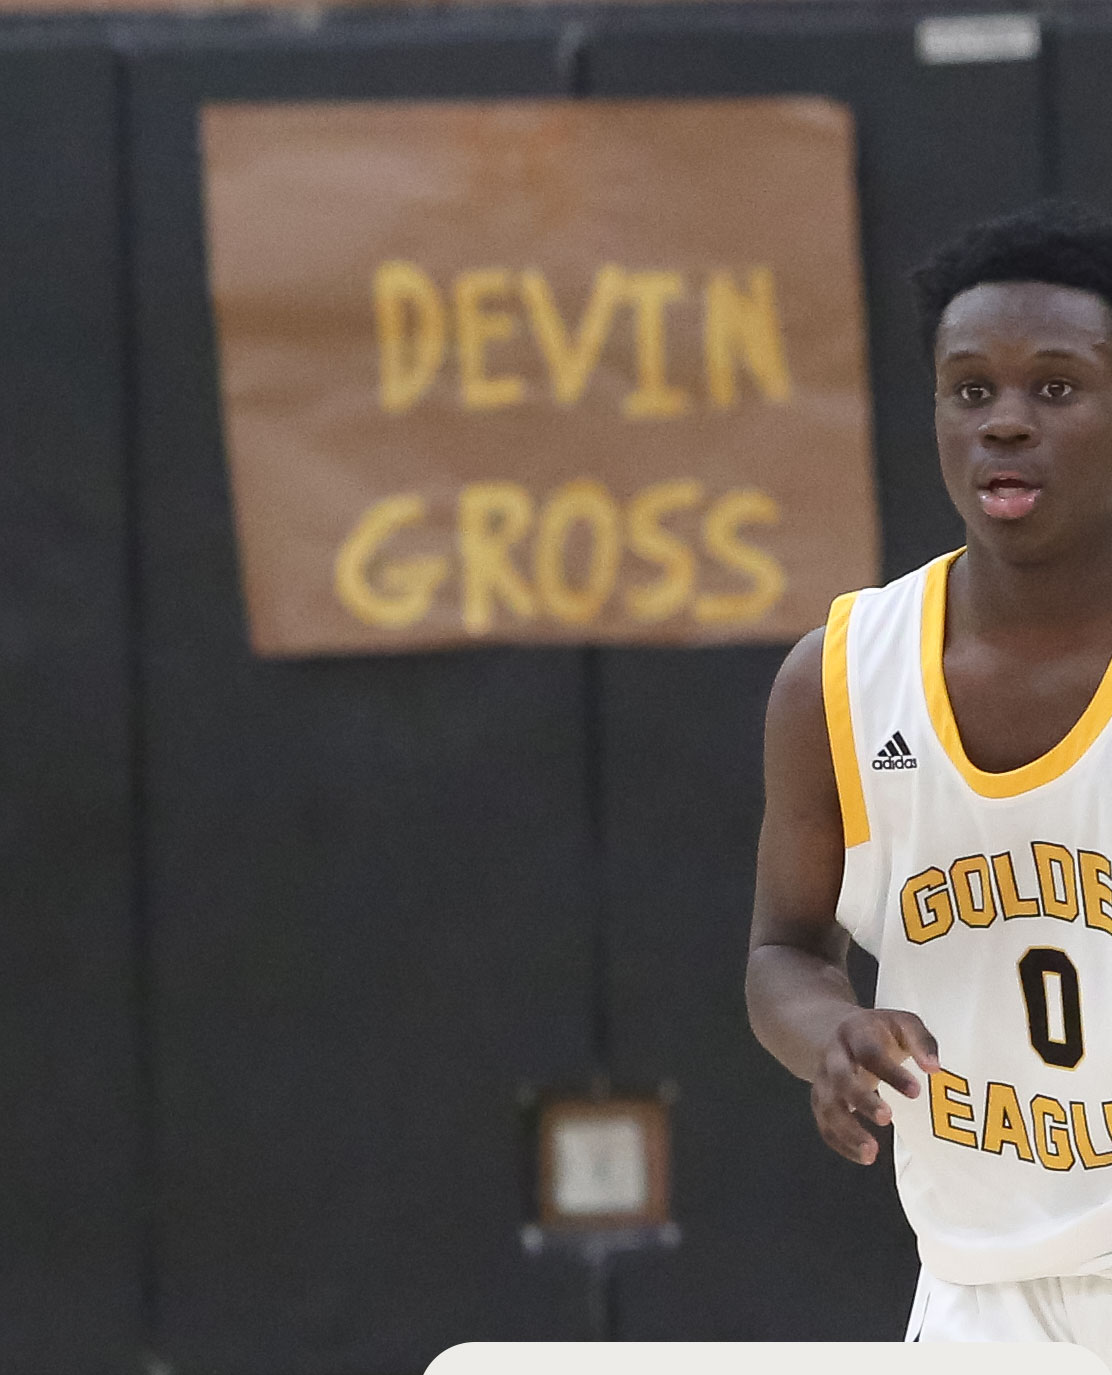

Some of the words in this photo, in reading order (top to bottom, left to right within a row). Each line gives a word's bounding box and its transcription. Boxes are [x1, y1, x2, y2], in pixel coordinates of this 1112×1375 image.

[372, 258, 794, 420] DEVIN
[334, 477, 786, 636] GROSS
[871, 756, 918, 771] adidas
[1018, 946, 1086, 1070] 0
